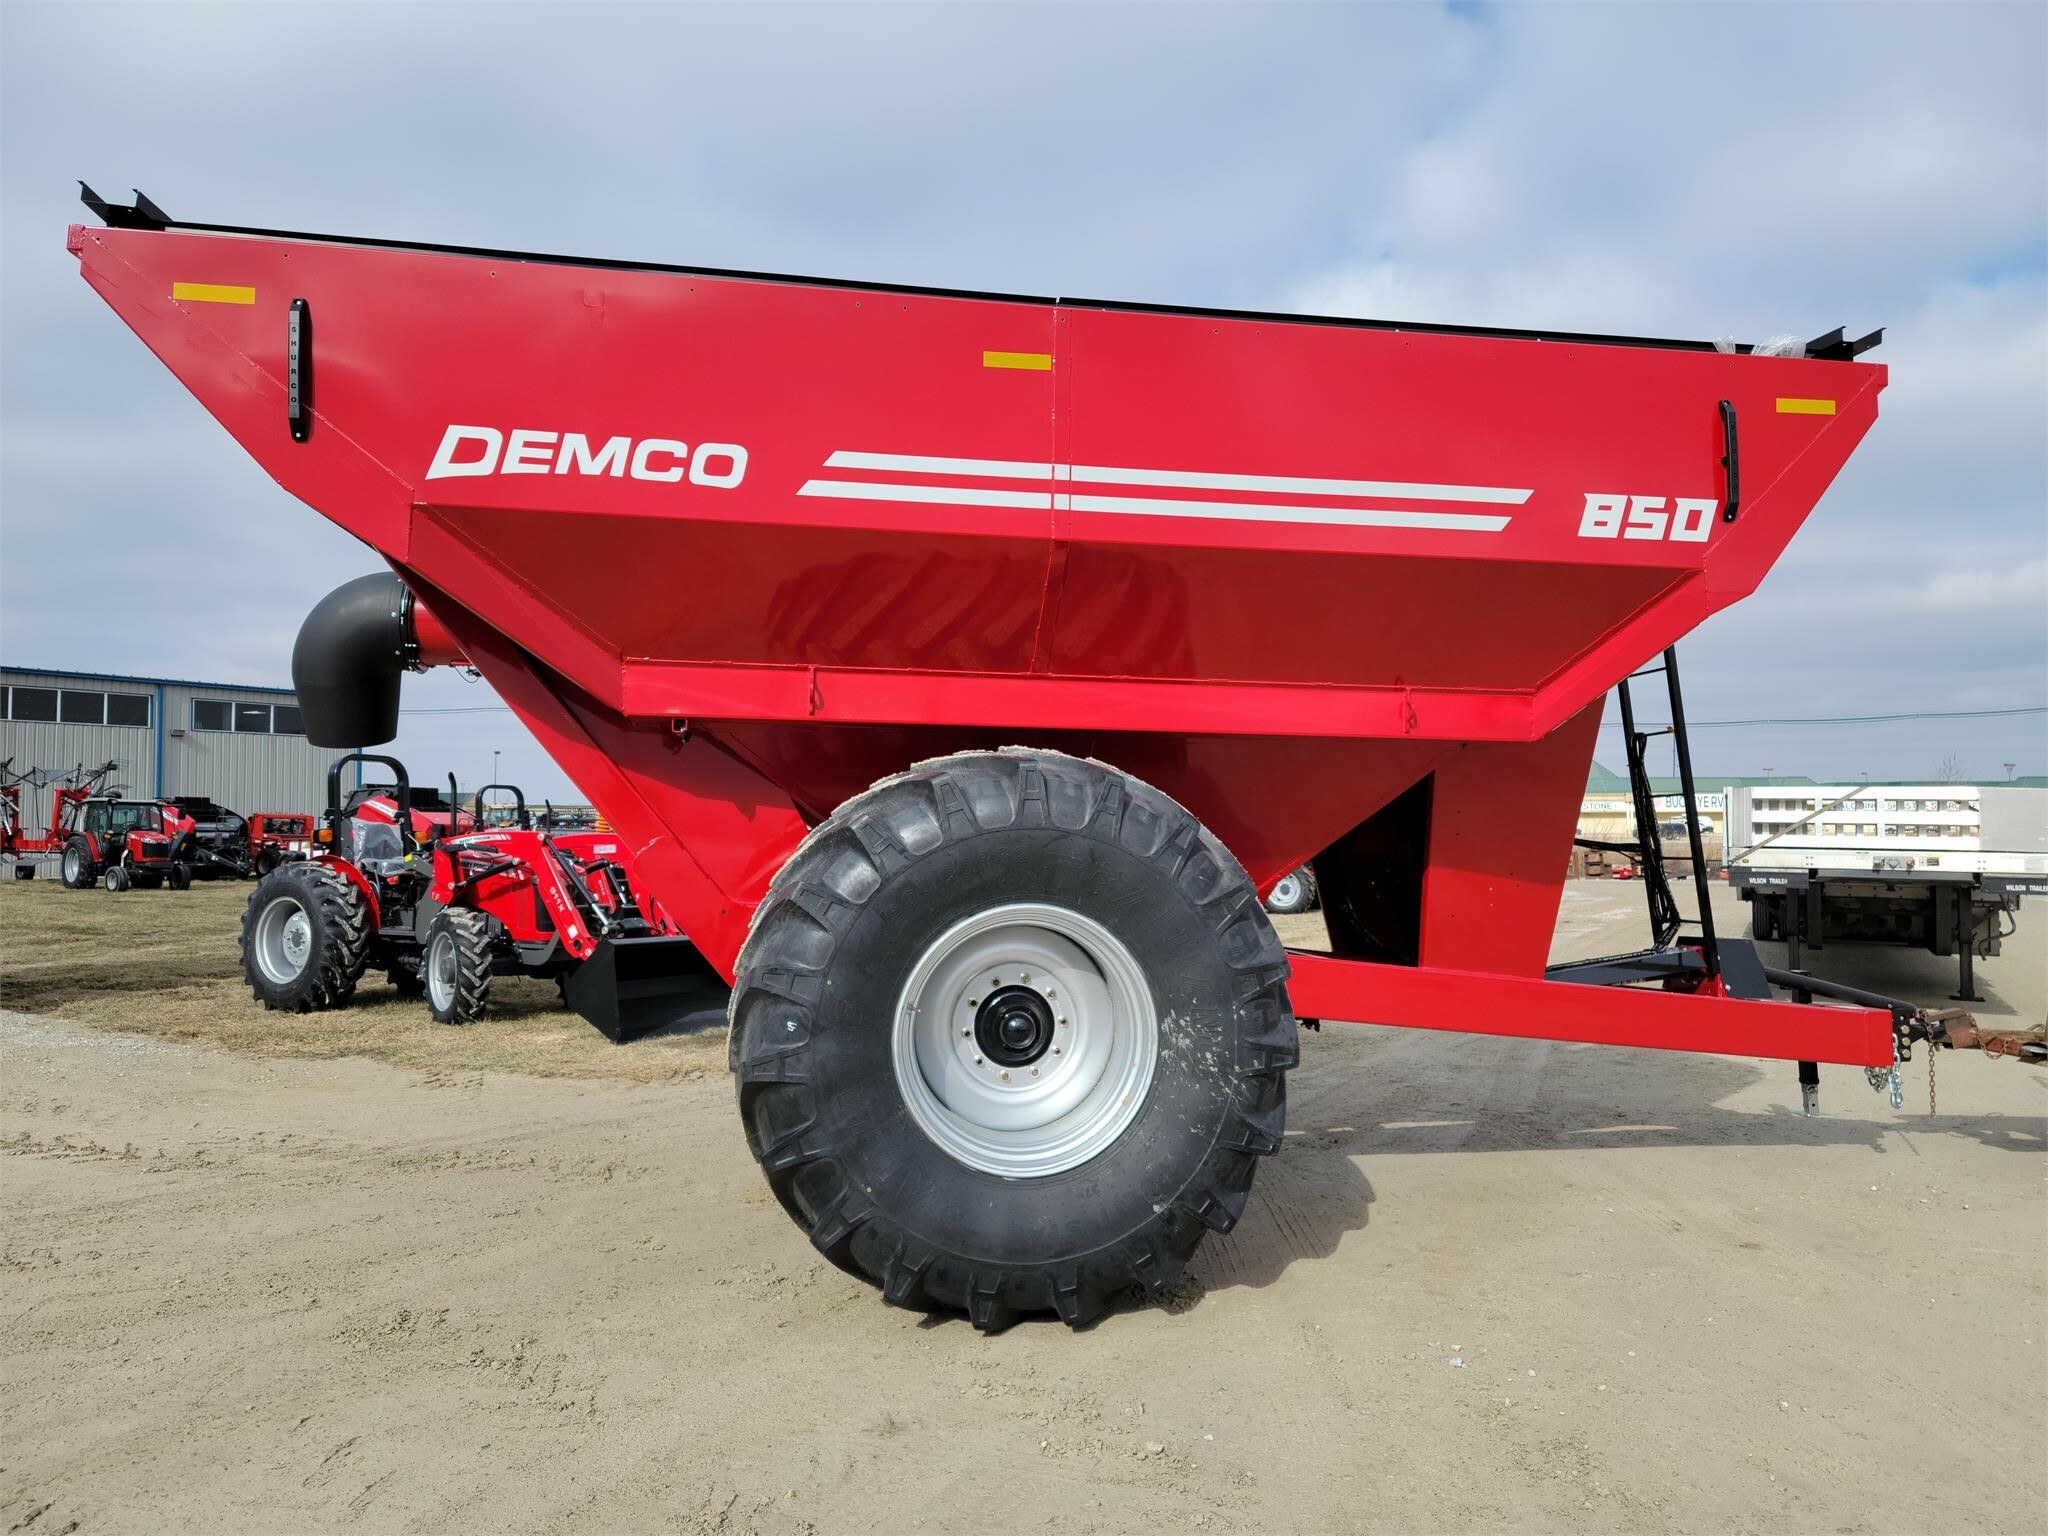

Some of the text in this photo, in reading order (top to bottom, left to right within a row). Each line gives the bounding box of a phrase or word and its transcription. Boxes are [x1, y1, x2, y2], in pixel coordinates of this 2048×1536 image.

[425, 424, 749, 489] DEMCO
[1577, 493, 1719, 543] 850
[1665, 796, 1709, 808] BUCYE
